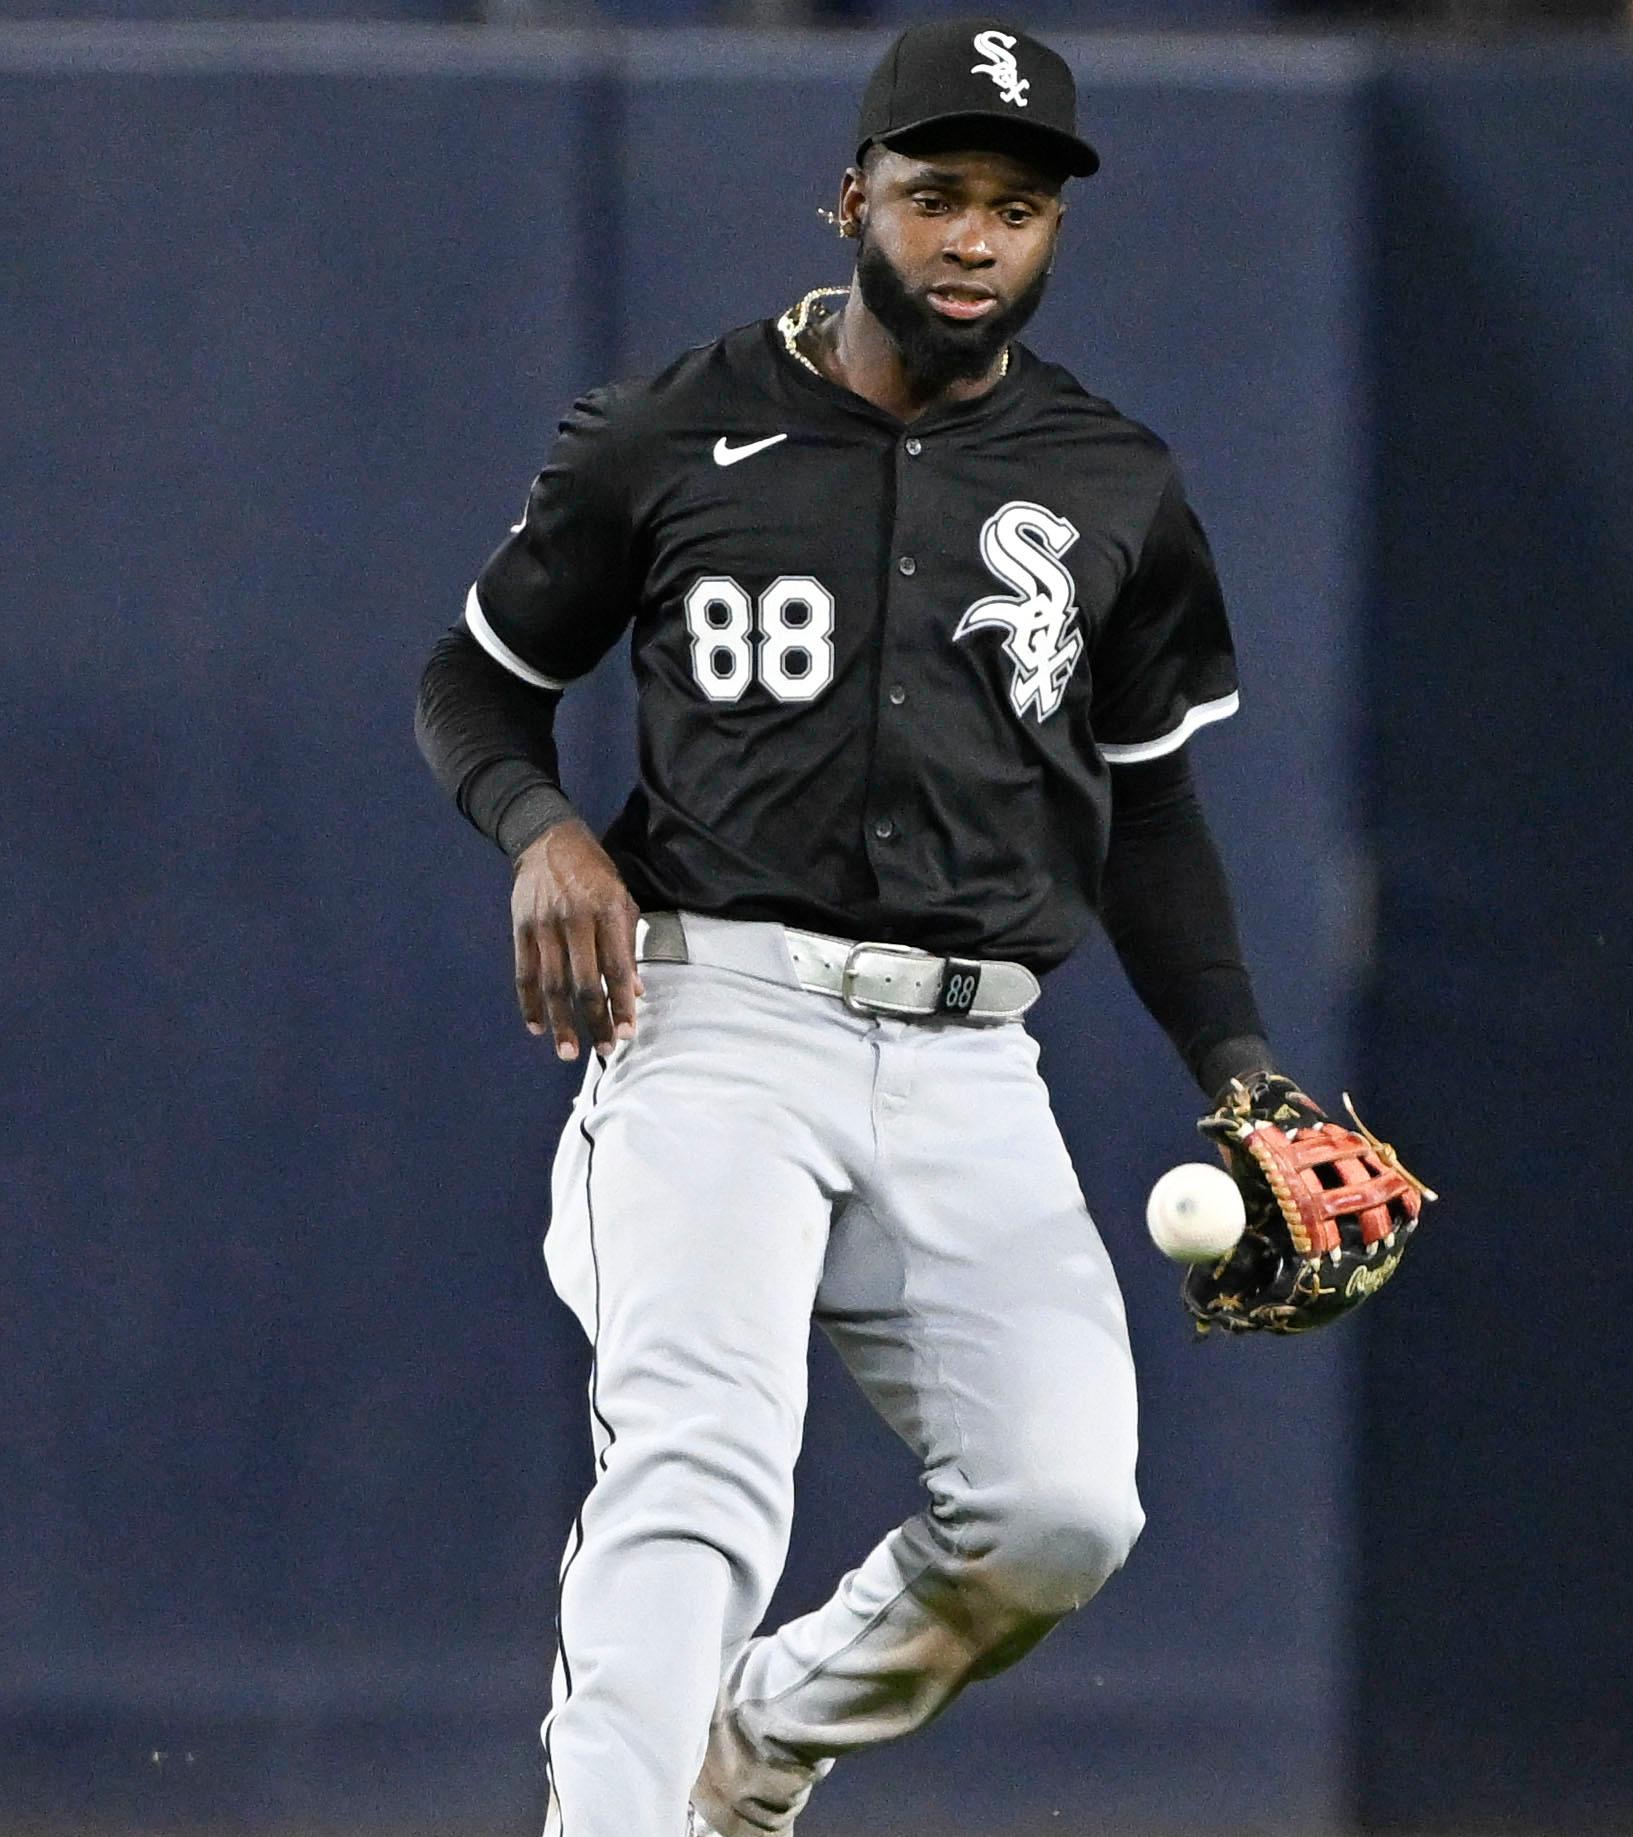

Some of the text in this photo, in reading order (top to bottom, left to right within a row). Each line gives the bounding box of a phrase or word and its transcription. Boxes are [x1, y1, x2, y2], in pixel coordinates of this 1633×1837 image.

[971, 30, 1030, 107] Sox
[684, 575, 835, 702] 88
[953, 500, 1084, 723] Sox
[946, 974, 975, 1008] 88
